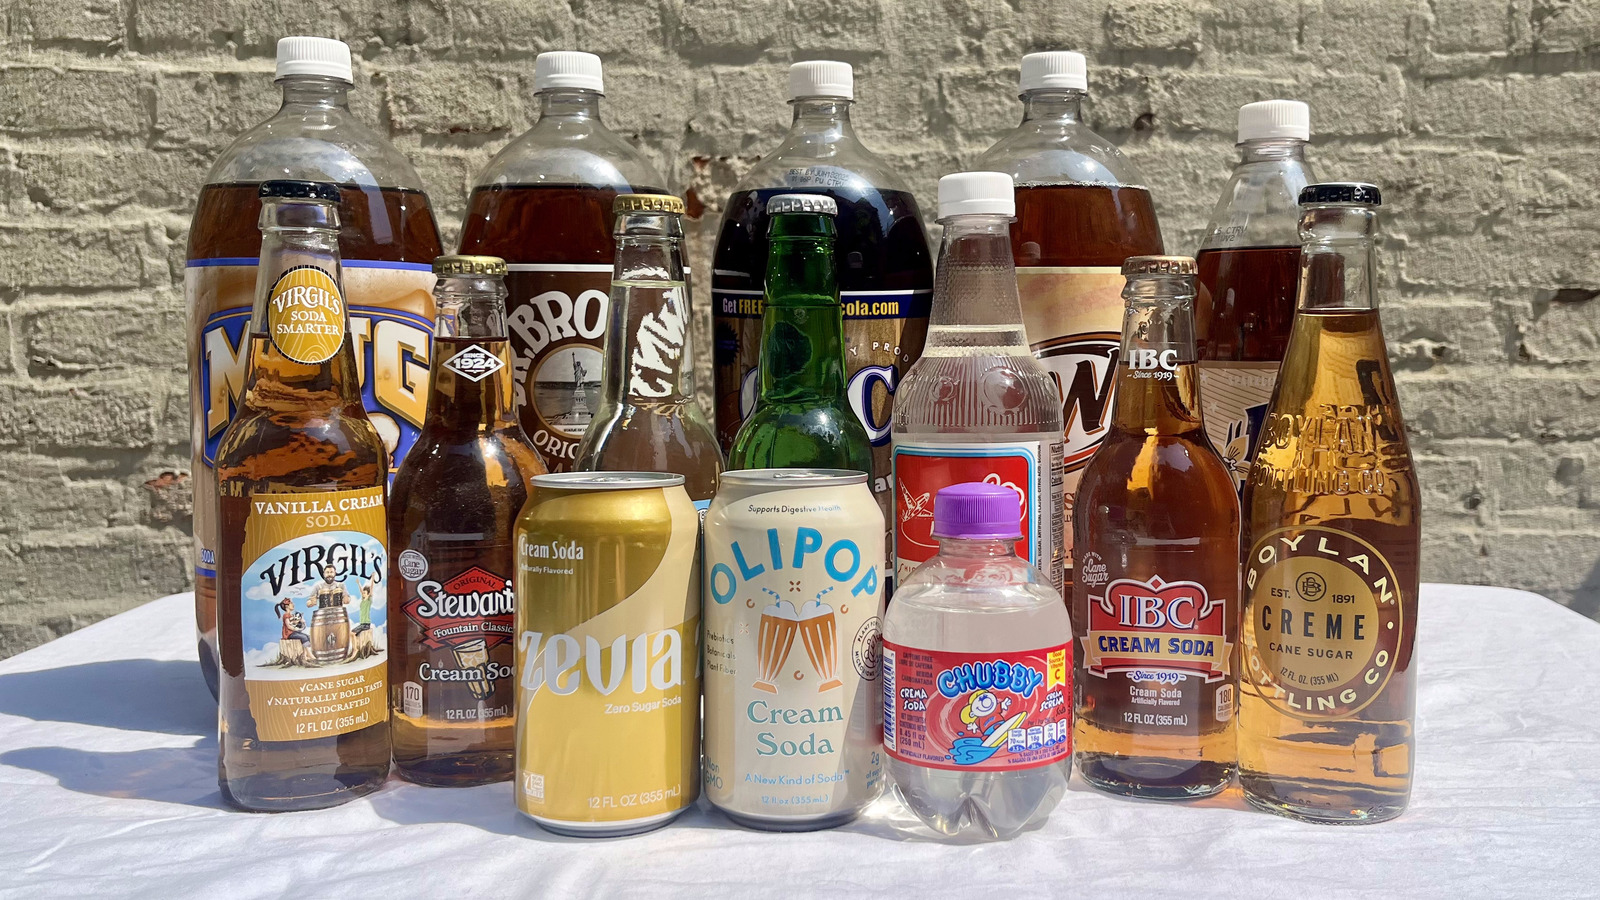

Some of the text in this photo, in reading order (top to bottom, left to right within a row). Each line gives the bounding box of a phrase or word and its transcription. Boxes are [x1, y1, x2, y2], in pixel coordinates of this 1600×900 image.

[272, 285, 340, 316] VIRGIL'S
[722, 297, 737, 314] Get
[738, 298, 764, 316] FREE
[290, 310, 327, 322] SODA
[276, 323, 340, 336] SMARTER
[453, 357, 497, 370] 1924
[1127, 348, 1178, 371] IBC
[1132, 370, 1173, 381] Since 1919
[254, 493, 384, 515] VANILLA CREAM
[747, 503, 780, 515] Supports
[781, 504, 817, 515] Digestive
[305, 513, 353, 529] SODA
[519, 535, 585, 561] Cream Soda
[403, 558, 421, 568] Cane
[1091, 551, 1102, 562] WITH
[259, 542, 383, 597] VIRGIL'S
[401, 565, 425, 576] Sugar
[520, 562, 574, 576] Naturally Flavored
[710, 526, 878, 605] OLIPOP
[1087, 558, 1107, 573] Cane
[1246, 534, 1394, 605] BOYLAN
[452, 576, 497, 591] ORIGINAL
[1081, 565, 1110, 589] Sugar
[1270, 587, 1291, 600] EST.
[1331, 593, 1356, 605] 1891
[1118, 593, 1200, 631] IBC
[433, 621, 479, 640] Fountain
[1261, 604, 1366, 641] CREME
[1097, 635, 1215, 658] CREAM SODA
[1268, 641, 1354, 661] CANE SUGAR
[418, 662, 483, 682] Cream
[936, 660, 1044, 699] CHUBBY
[1054, 668, 1061, 681] C
[1133, 670, 1179, 683] Since 1919
[1280, 666, 1340, 687] 12 FL. OZ. (355 ML)
[305, 674, 366, 693] CANE SUGAR
[1129, 685, 1183, 698] Cream Soda
[274, 680, 384, 706] NATURALLY BOLD TASTE
[404, 685, 420, 701] 170
[899, 688, 928, 700] CREMA
[1046, 689, 1063, 701] CREAM
[1219, 688, 1232, 704] 180
[299, 696, 371, 717] HANDCRAFTED
[604, 694, 682, 714] Zero Sugar Soda
[902, 700, 926, 712] SODA
[1039, 696, 1065, 712] SCREAM
[1131, 696, 1181, 707] Artificially Flavored
[445, 704, 508, 720] 12 FL OZ mL)
[746, 699, 844, 724] Cream
[1123, 711, 1188, 726] 12 FL OZ (355 mL)
[296, 710, 369, 734] 12 FL OZ (355 mL)
[755, 731, 835, 756] Soda
[912, 739, 925, 750] mL)
[918, 733, 926, 741] oz
[706, 755, 720, 774] Non
[871, 751, 880, 766] 2g
[705, 770, 724, 790] GMO
[744, 772, 752, 783] A
[753, 774, 777, 786] New
[778, 775, 803, 786] Kind
[804, 774, 816, 785] of
[587, 783, 682, 809] 12 FL OZ (355 mL)
[761, 796, 770, 805] 12
[771, 796, 778, 805] fl
[791, 796, 812, 806] (355
[812, 794, 830, 804] mL)
